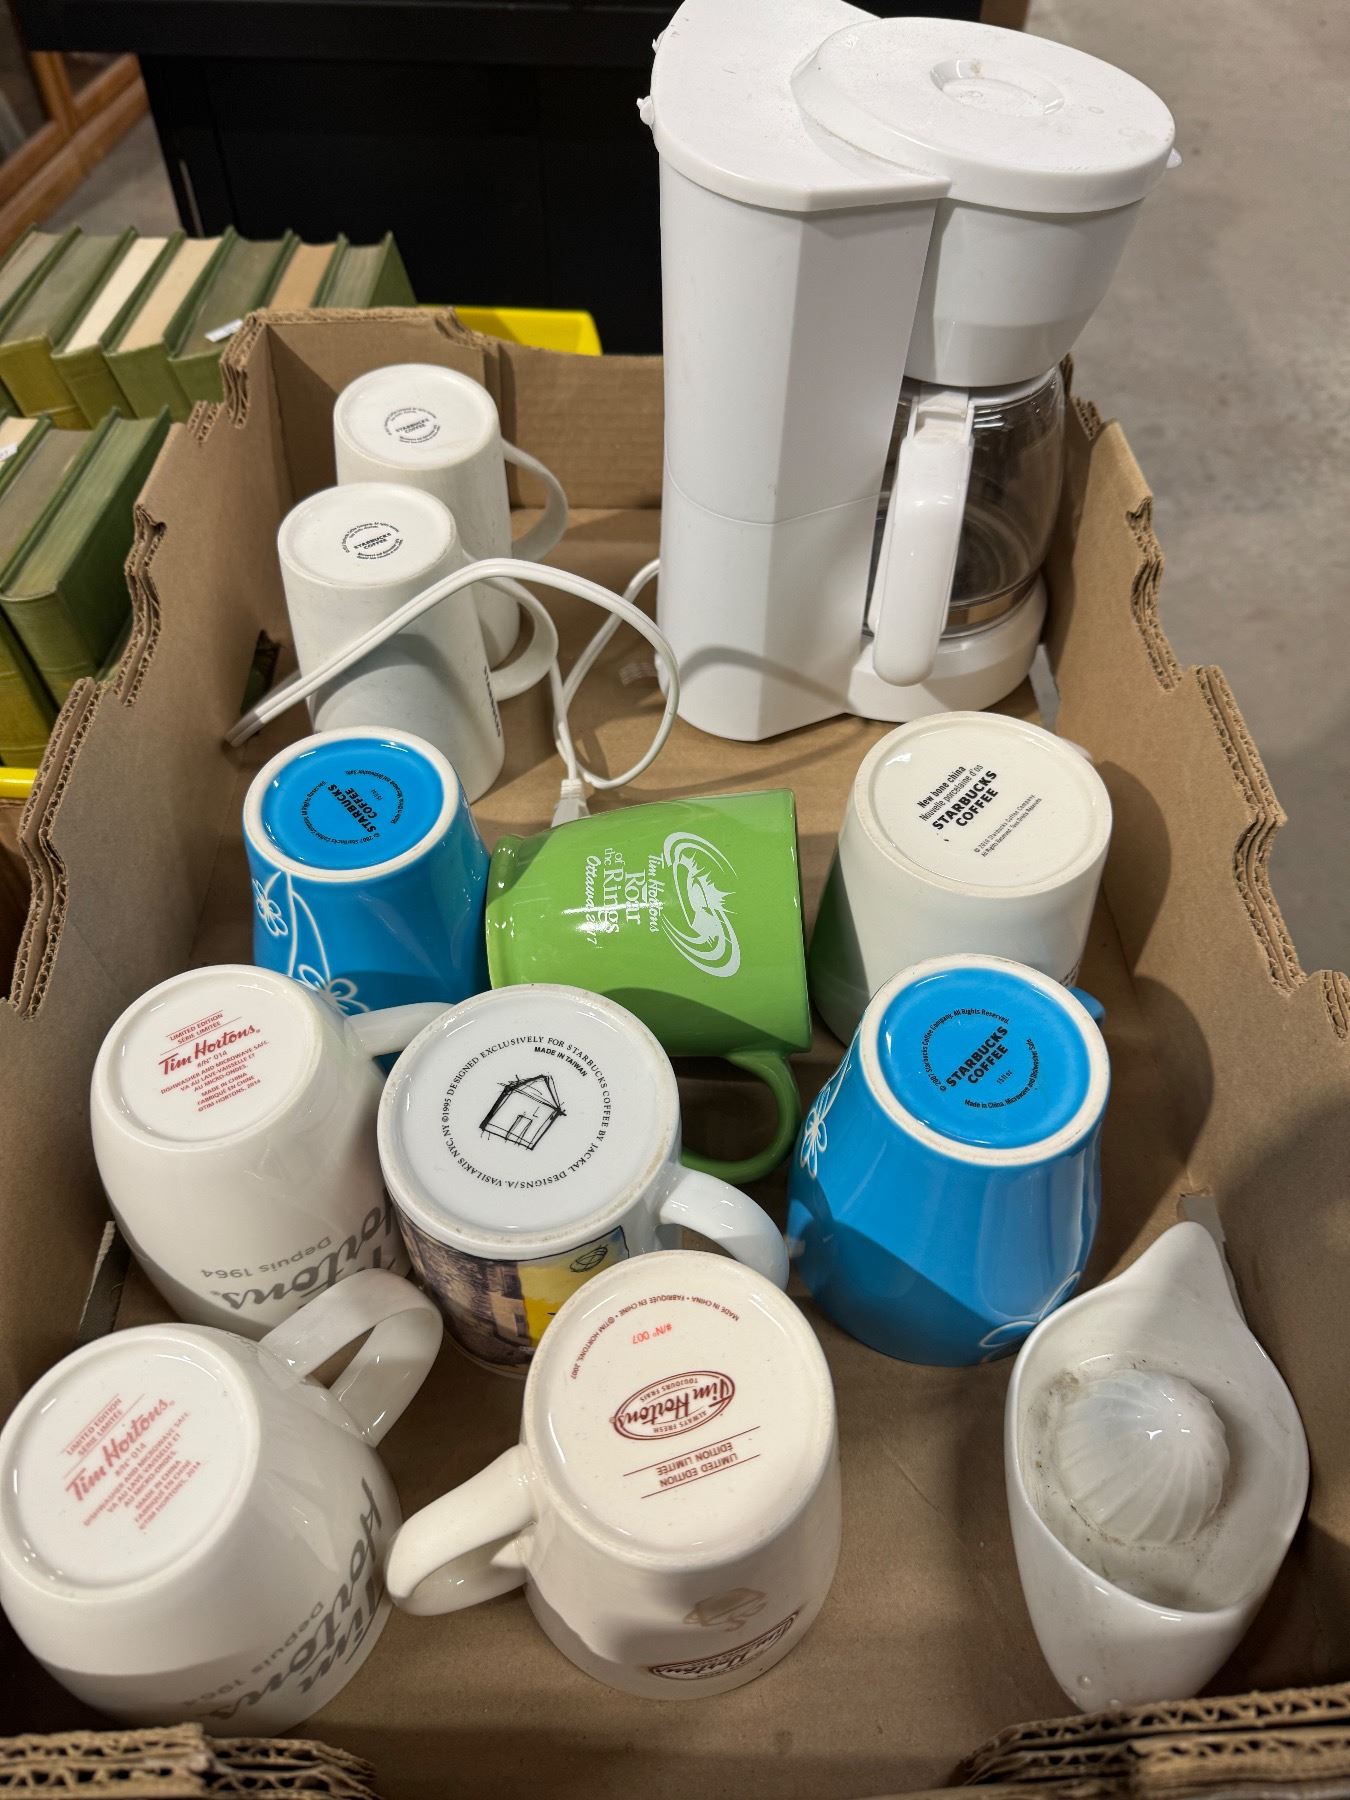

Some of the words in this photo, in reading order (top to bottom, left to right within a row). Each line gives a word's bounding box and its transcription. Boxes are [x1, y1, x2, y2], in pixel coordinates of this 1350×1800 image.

[353, 532, 392, 549] STARBUCKS
[363, 538, 388, 550] COFFEE
[917, 795, 933, 809] New
[930, 781, 949, 797] bone
[947, 766, 966, 784] china
[918, 800, 946, 821] Nouvelle
[943, 774, 972, 803] porcelaine
[932, 770, 997, 830] STARBUCKS
[328, 784, 376, 833] STARBUCKS
[345, 788, 377, 819] COFFEE
[955, 788, 999, 826] COFFEE
[604, 847, 616, 866] the
[614, 852, 626, 866] of
[648, 853, 665, 881] Tim
[585, 855, 602, 910] Ottawa
[598, 866, 624, 934] Rings
[624, 868, 646, 925] Roar
[648, 880, 666, 933] Hortons
[170, 1027, 196, 1041] LIMITED
[197, 1013, 223, 1029] EDITION
[922, 1028, 933, 1046] Coffee
[158, 1053, 192, 1075] Tim
[194, 1025, 256, 1059] Hortons
[478, 1035, 544, 1058] EXCLUSIVELY
[546, 1037, 566, 1048] FOR
[534, 1046, 556, 1056] MADE
[557, 1051, 566, 1060] IN
[565, 1055, 588, 1077] TAIWAN
[565, 1043, 608, 1089] STARBUCKS
[921, 1045, 932, 1072] Starbucks
[946, 1026, 1008, 1087] STARBUCKS
[967, 1044, 1008, 1084] COFFEE
[160, 1072, 201, 1095] DISHWASHER
[201, 1064, 215, 1075] AND
[215, 1048, 253, 1068] MICROWAVE
[228, 1084, 236, 1092] EN
[236, 1075, 255, 1088] CHINE
[446, 1054, 480, 1096] DESIGNED
[194, 1084, 204, 1092] AU
[201, 1086, 219, 1097] MADE
[229, 1072, 248, 1083] CHINA
[600, 1089, 610, 1128] COFFEE
[963, 1098, 980, 1108] Made
[441, 1124, 451, 1137] NY
[595, 1129, 606, 1141] BY
[566, 1142, 599, 1174] JACKAL
[456, 1156, 503, 1187] VASILAKIS
[258, 1236, 332, 1273] Depuis
[201, 1268, 253, 1279] 1964
[617, 1301, 638, 1316] CHINE
[636, 1298, 647, 1307] EN
[690, 1295, 712, 1307] CHINA
[711, 1302, 720, 1310] IN
[720, 1306, 740, 1321] MADE
[576, 1330, 599, 1363] HORTONS,
[632, 1331, 650, 1345] 007
[570, 1362, 580, 1379] 2007
[640, 1388, 660, 1402] FRAIS
[662, 1377, 698, 1392] TOUJOURS
[693, 1378, 733, 1408] Tim
[617, 1392, 690, 1428] Hortons
[679, 1410, 707, 1428] ALWAYS
[66, 1426, 95, 1456] LIMITED
[93, 1398, 122, 1427] EDITION
[653, 1424, 678, 1433] FRESH
[65, 1467, 107, 1501] Tim
[102, 1399, 169, 1468] Hortons
[701, 1452, 738, 1473] LIMITED
[83, 1482, 124, 1527] DISHWASHER
[124, 1467, 139, 1483] AND
[137, 1427, 176, 1468] MICROWAVE
[186, 1461, 201, 1478] 2014
[657, 1454, 693, 1476] LIMITÉE
[135, 1489, 156, 1510] MADE
[153, 1479, 163, 1489] IN
[161, 1459, 182, 1482] CHINA
[164, 1480, 175, 1491] EN
[659, 1468, 698, 1488] EDITION
[117, 1490, 129, 1503] AU
[124, 1495, 136, 1508] AU
